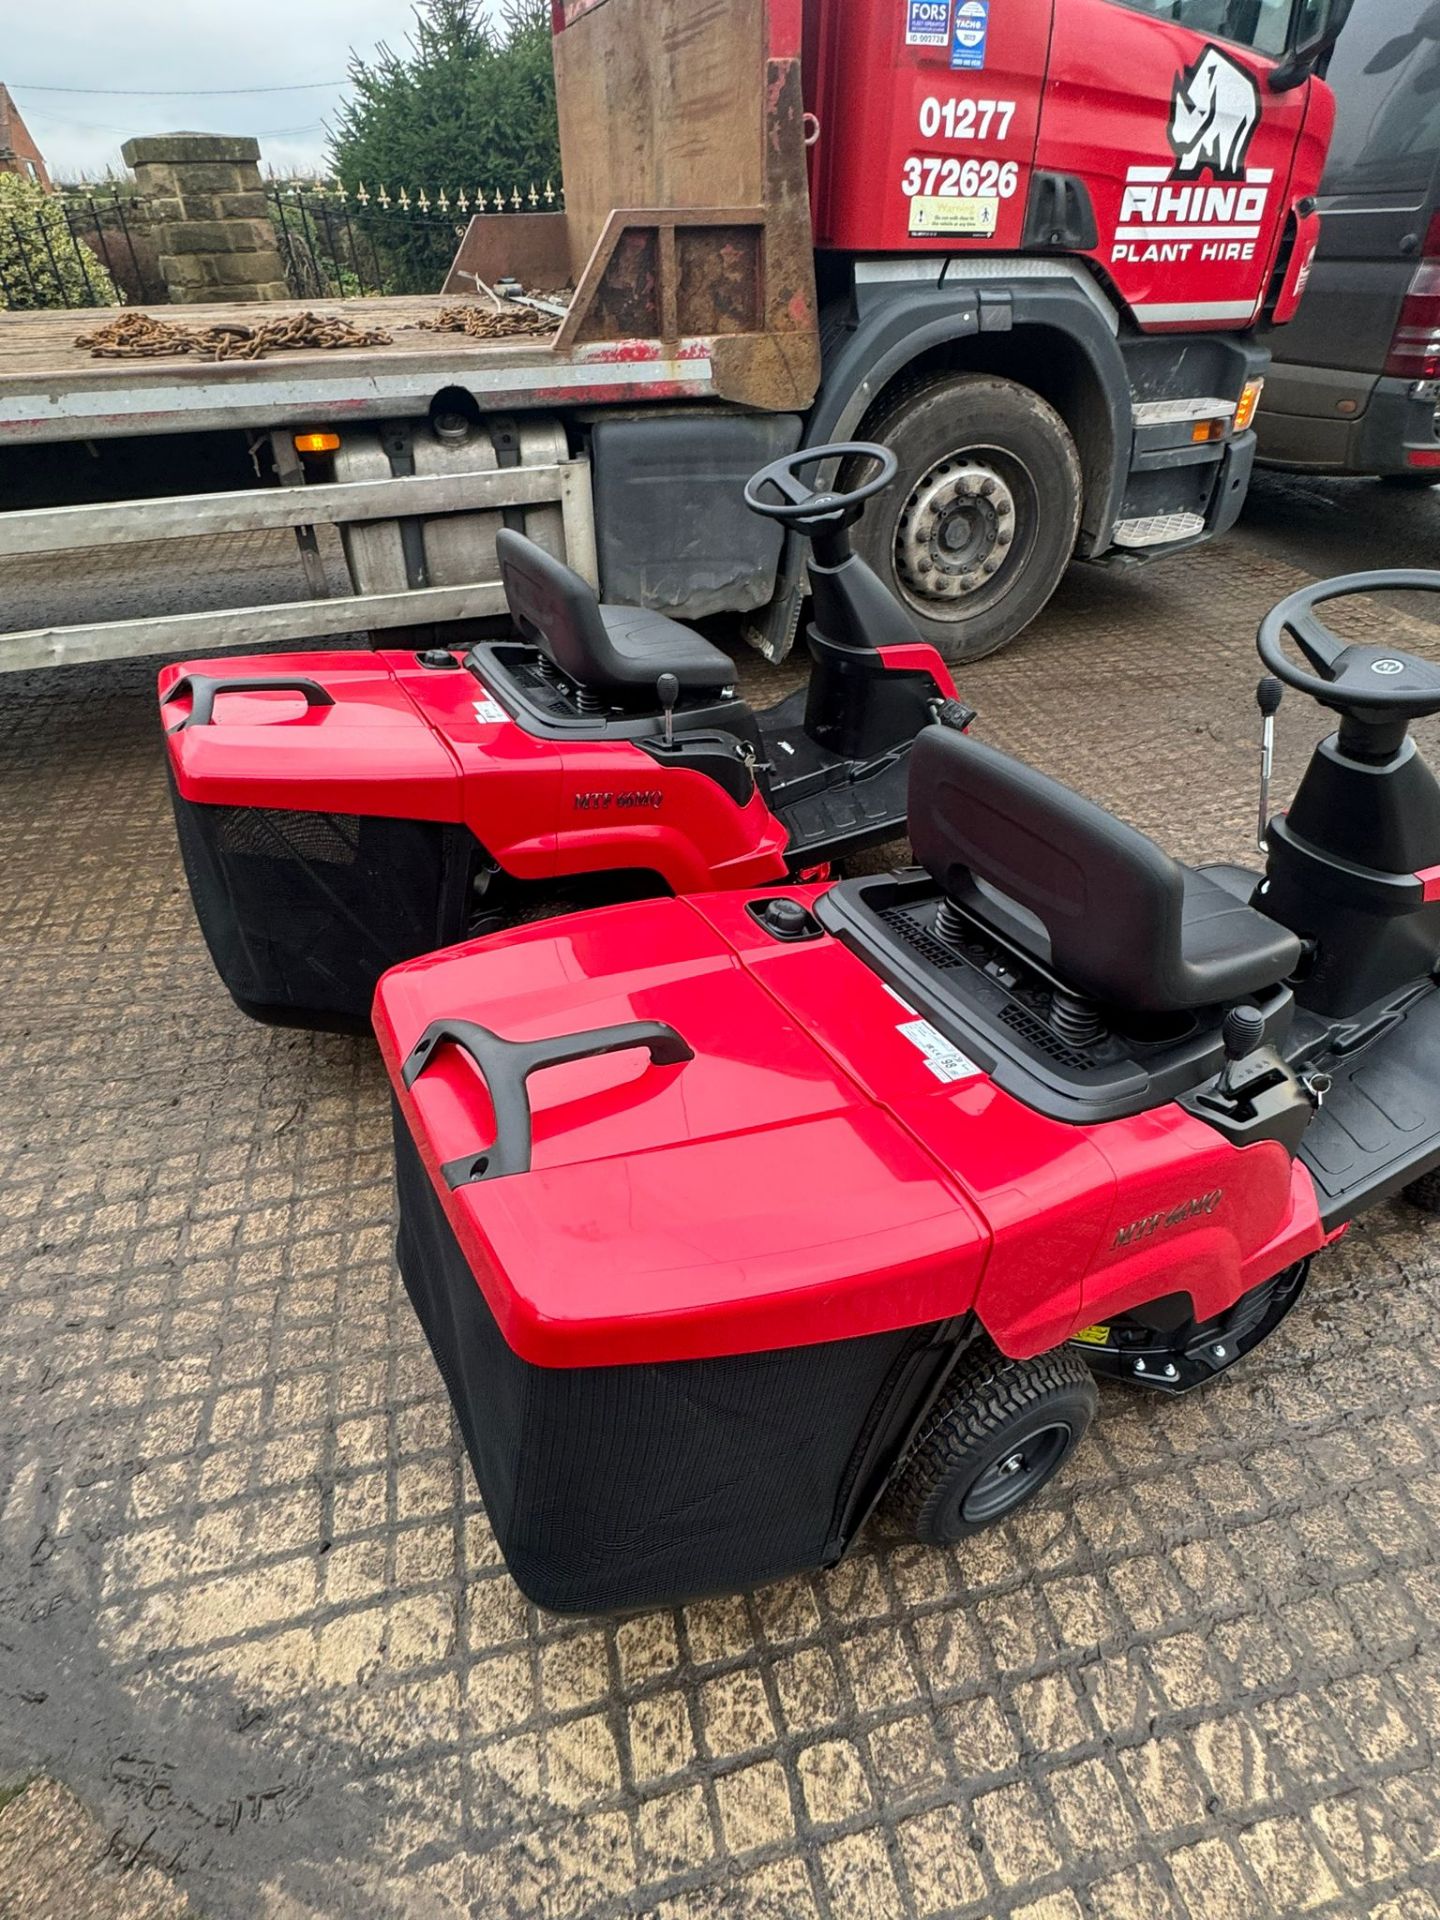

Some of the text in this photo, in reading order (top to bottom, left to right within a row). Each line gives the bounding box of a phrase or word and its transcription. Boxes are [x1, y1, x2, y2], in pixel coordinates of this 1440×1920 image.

[912, 3, 946, 21] FORS
[919, 96, 1016, 140] 01277
[901, 157, 1019, 198] 372626
[1119, 186, 1269, 222] RHINO
[1110, 242, 1256, 263] PLANT HIRE
[575, 792, 614, 809] MTF
[1109, 1218, 1166, 1251] MTF
